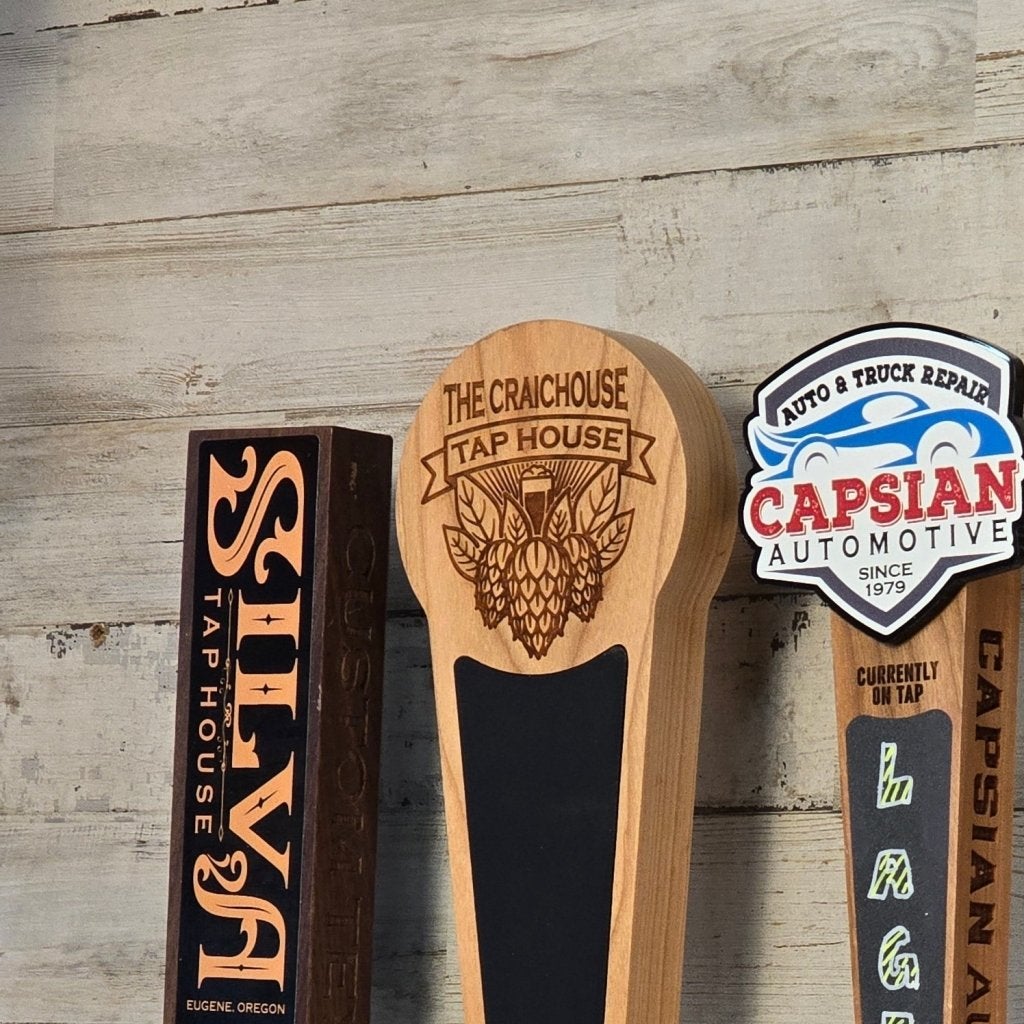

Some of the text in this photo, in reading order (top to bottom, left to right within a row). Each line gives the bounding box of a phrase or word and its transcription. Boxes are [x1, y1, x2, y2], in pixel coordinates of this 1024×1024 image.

[443, 366, 629, 425] THE CRAICHOUSE
[781, 363, 990, 426] AUTO & TRUCK REPAIR
[451, 425, 623, 464] TAP HOUSE
[750, 459, 1021, 538] CAPSIAN
[768, 518, 1008, 566] AUTOMOTIVE
[858, 562, 913, 581] SINCE
[866, 581, 906, 597] 1979
[857, 661, 939, 687] CURRENTLY
[872, 684, 924, 705] ON TAP
[193, 445, 305, 992] SILVA
[194, 587, 222, 834] TAP HOUSE
[967, 628, 1005, 946] CAPSIAN
[237, 1001, 286, 1015] OREGON
